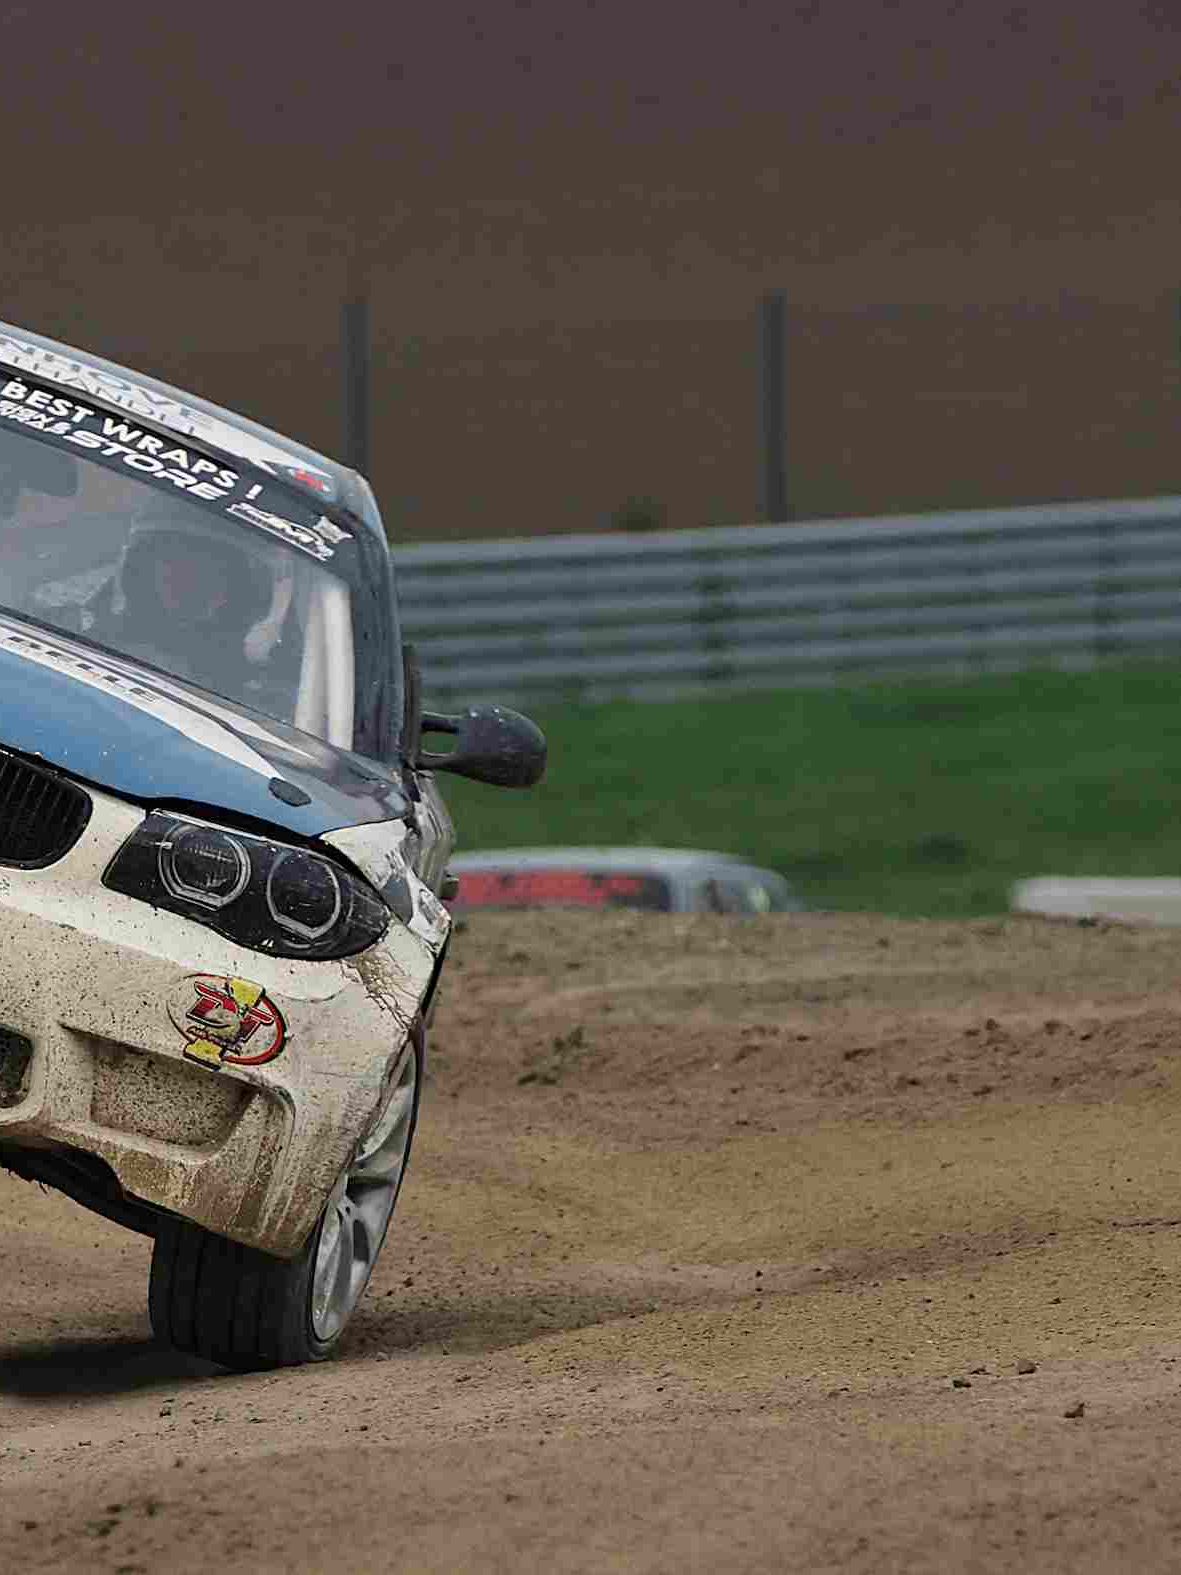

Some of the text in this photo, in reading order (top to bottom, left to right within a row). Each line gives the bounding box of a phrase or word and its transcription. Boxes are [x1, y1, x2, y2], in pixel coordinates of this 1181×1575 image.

[1, 380, 94, 422] BEST
[101, 418, 239, 488] WRAPS
[63, 430, 229, 500] STORE
